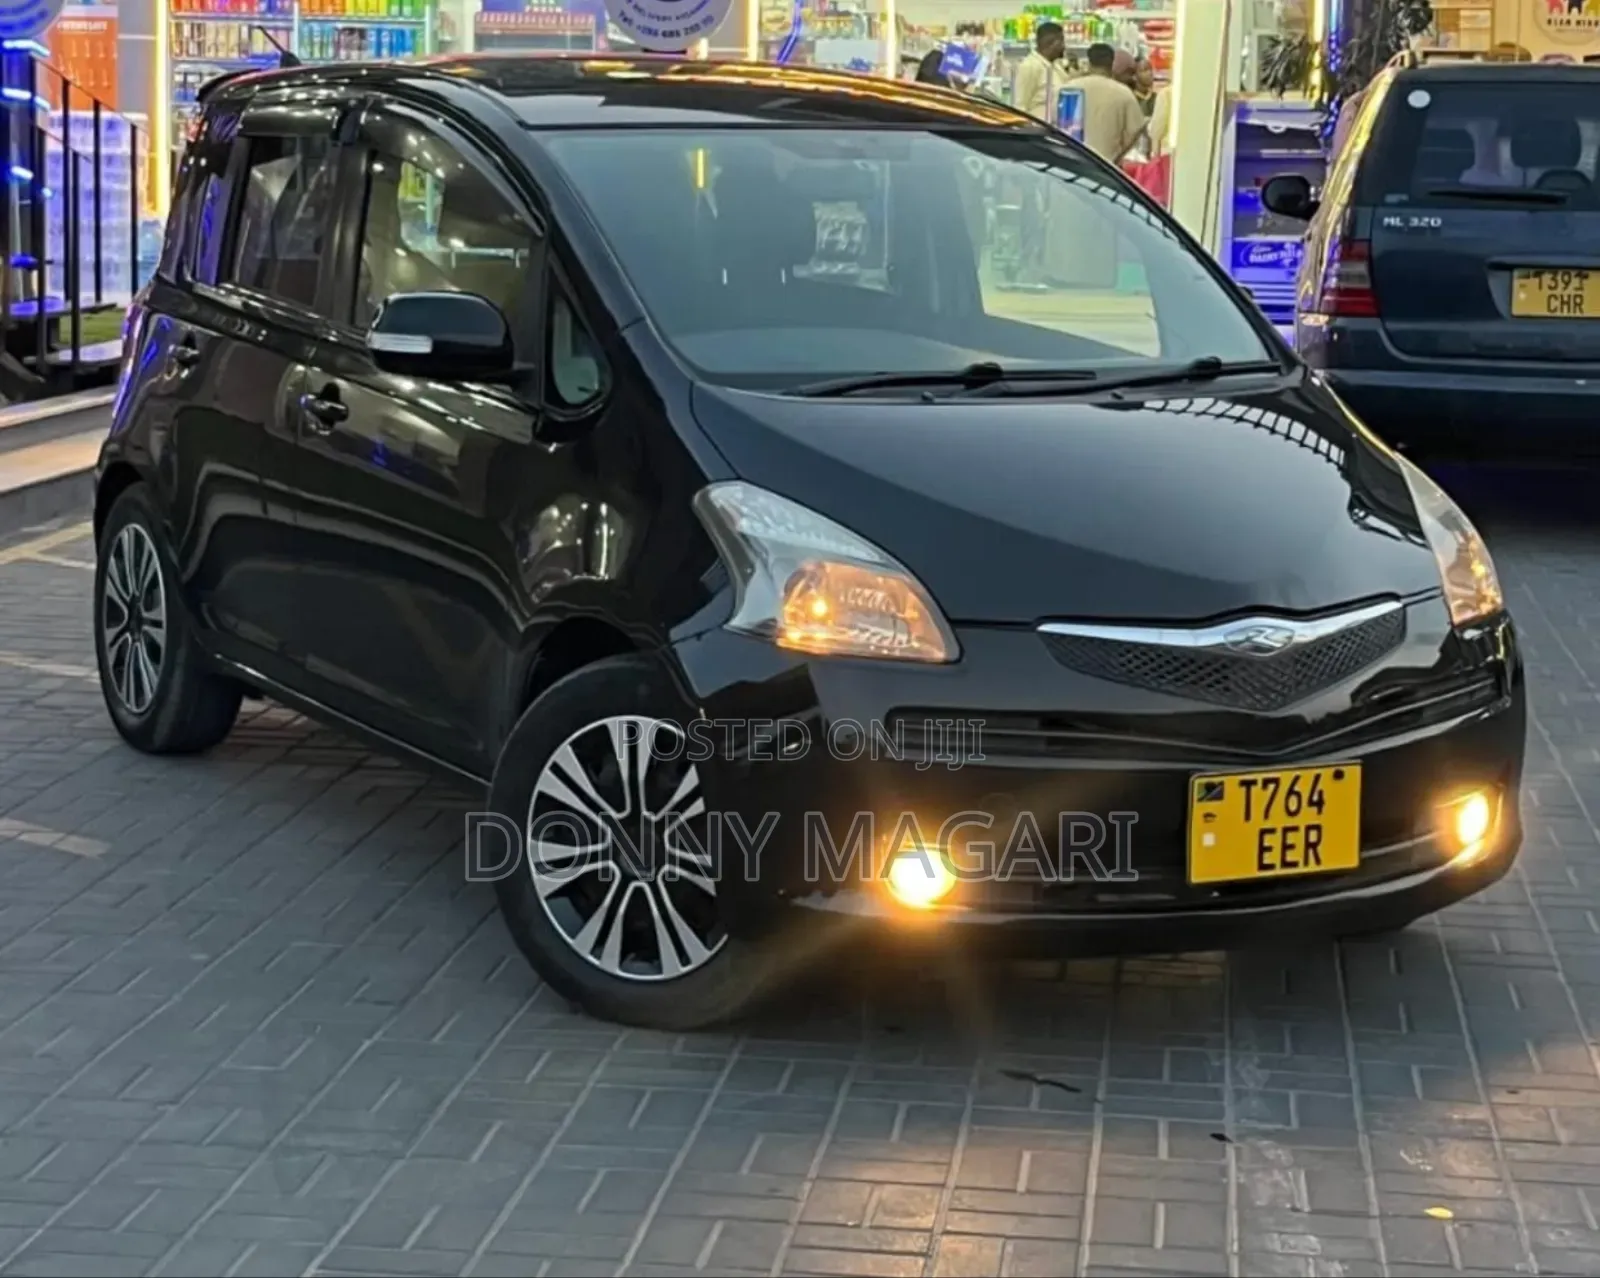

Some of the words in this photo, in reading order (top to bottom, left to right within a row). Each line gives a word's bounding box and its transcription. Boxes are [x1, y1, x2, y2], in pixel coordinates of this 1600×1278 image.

[1383, 216, 1404, 228] ML
[1409, 216, 1442, 228] 320
[1547, 294, 1584, 314] CHR
[1239, 772, 1325, 822] T764
[1257, 824, 1323, 871] EER
